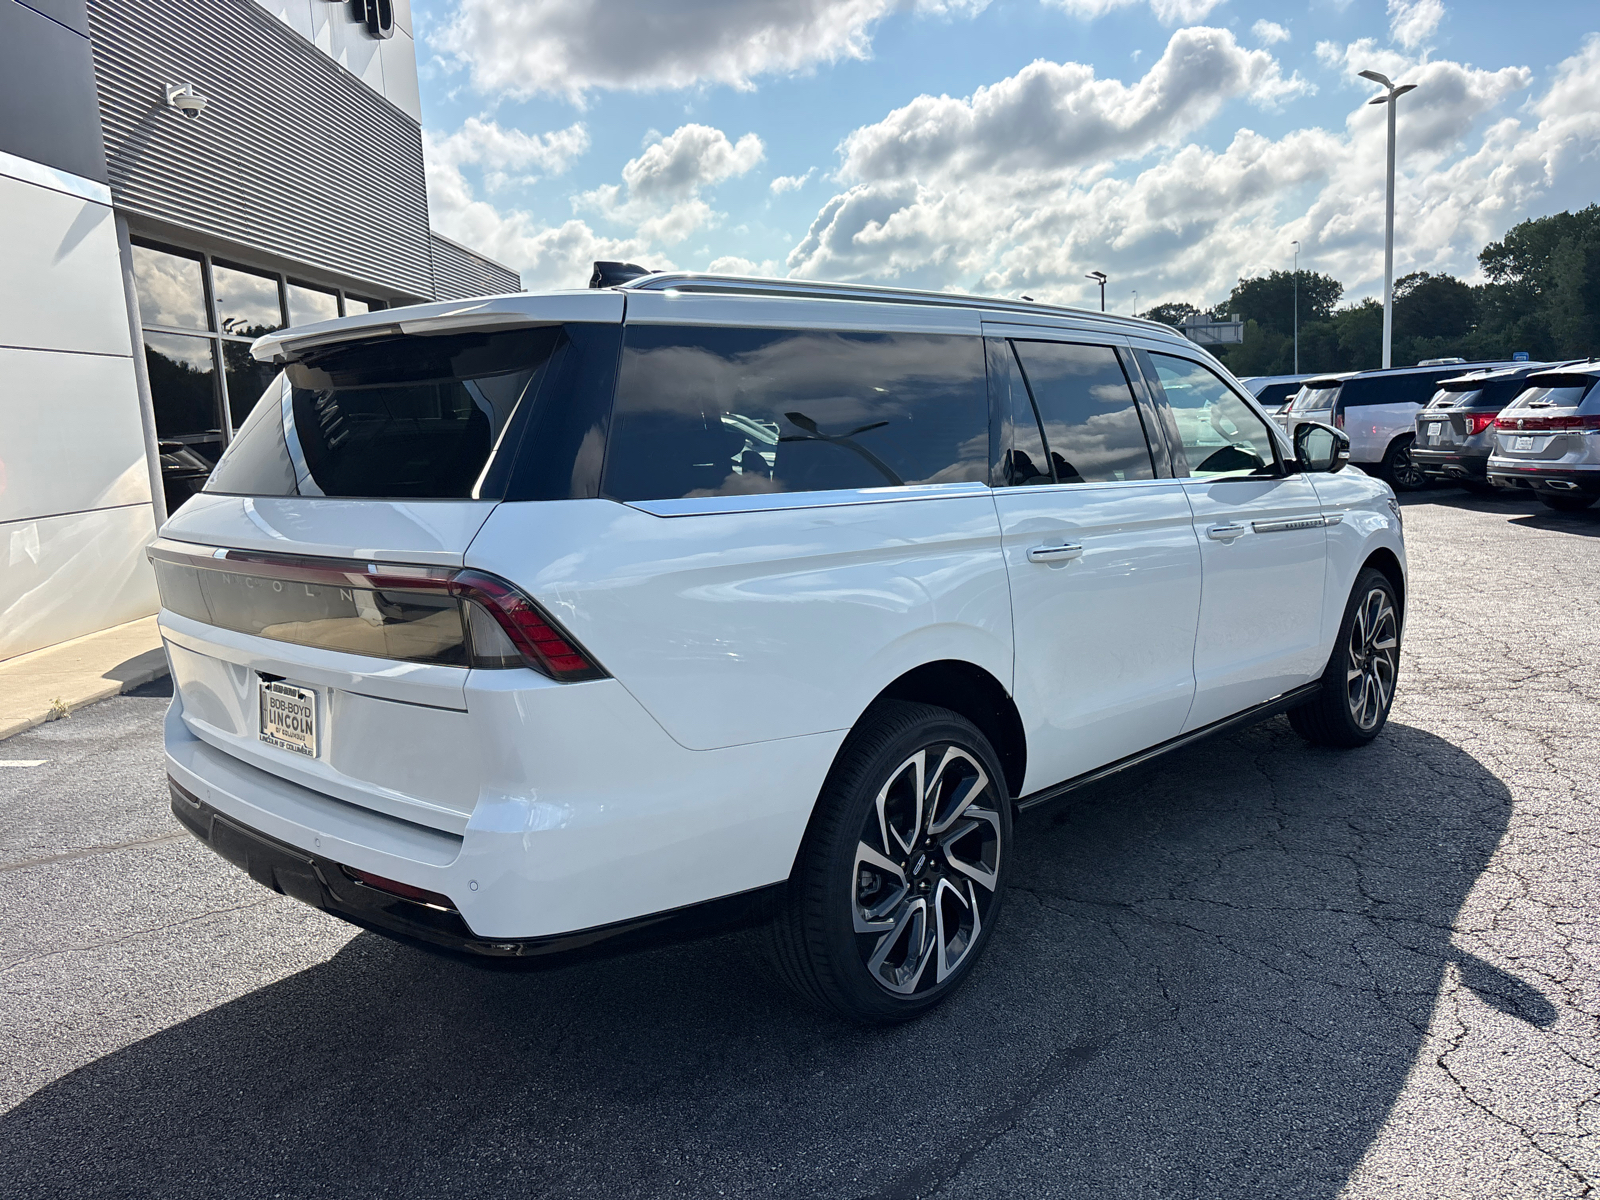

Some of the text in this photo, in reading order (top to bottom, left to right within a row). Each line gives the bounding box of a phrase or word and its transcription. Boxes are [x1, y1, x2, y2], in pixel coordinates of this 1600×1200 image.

[1285, 520, 1322, 528] NAVIGATOR
[270, 697, 311, 718] BOB-BOYD
[269, 709, 313, 736] LINCOLN
[259, 735, 313, 756] LINCOLN OF COLUMBUS
